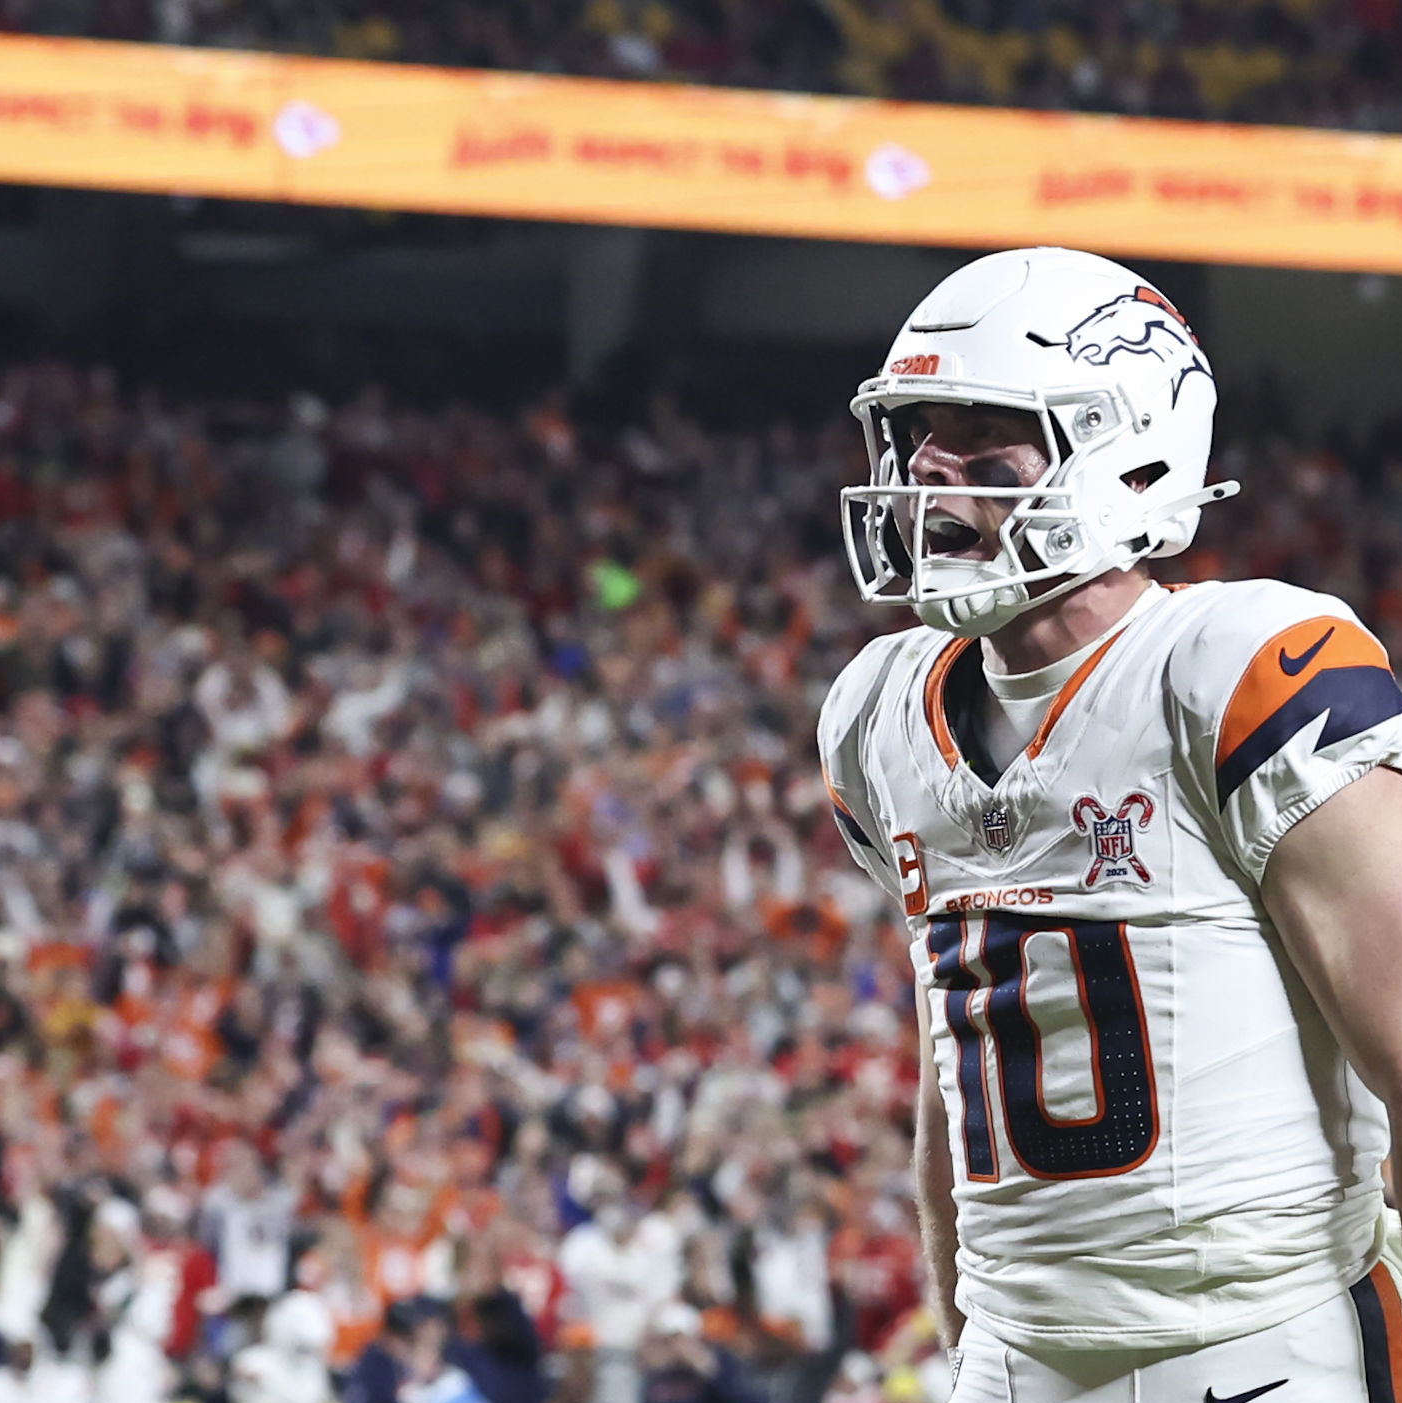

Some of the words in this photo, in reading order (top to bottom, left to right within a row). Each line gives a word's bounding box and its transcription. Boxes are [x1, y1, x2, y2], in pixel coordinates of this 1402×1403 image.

[1099, 835, 1131, 858] NFL
[1105, 867, 1128, 878] 2025
[945, 887, 1055, 913] BRONCOS
[927, 911, 1161, 1184] 10
